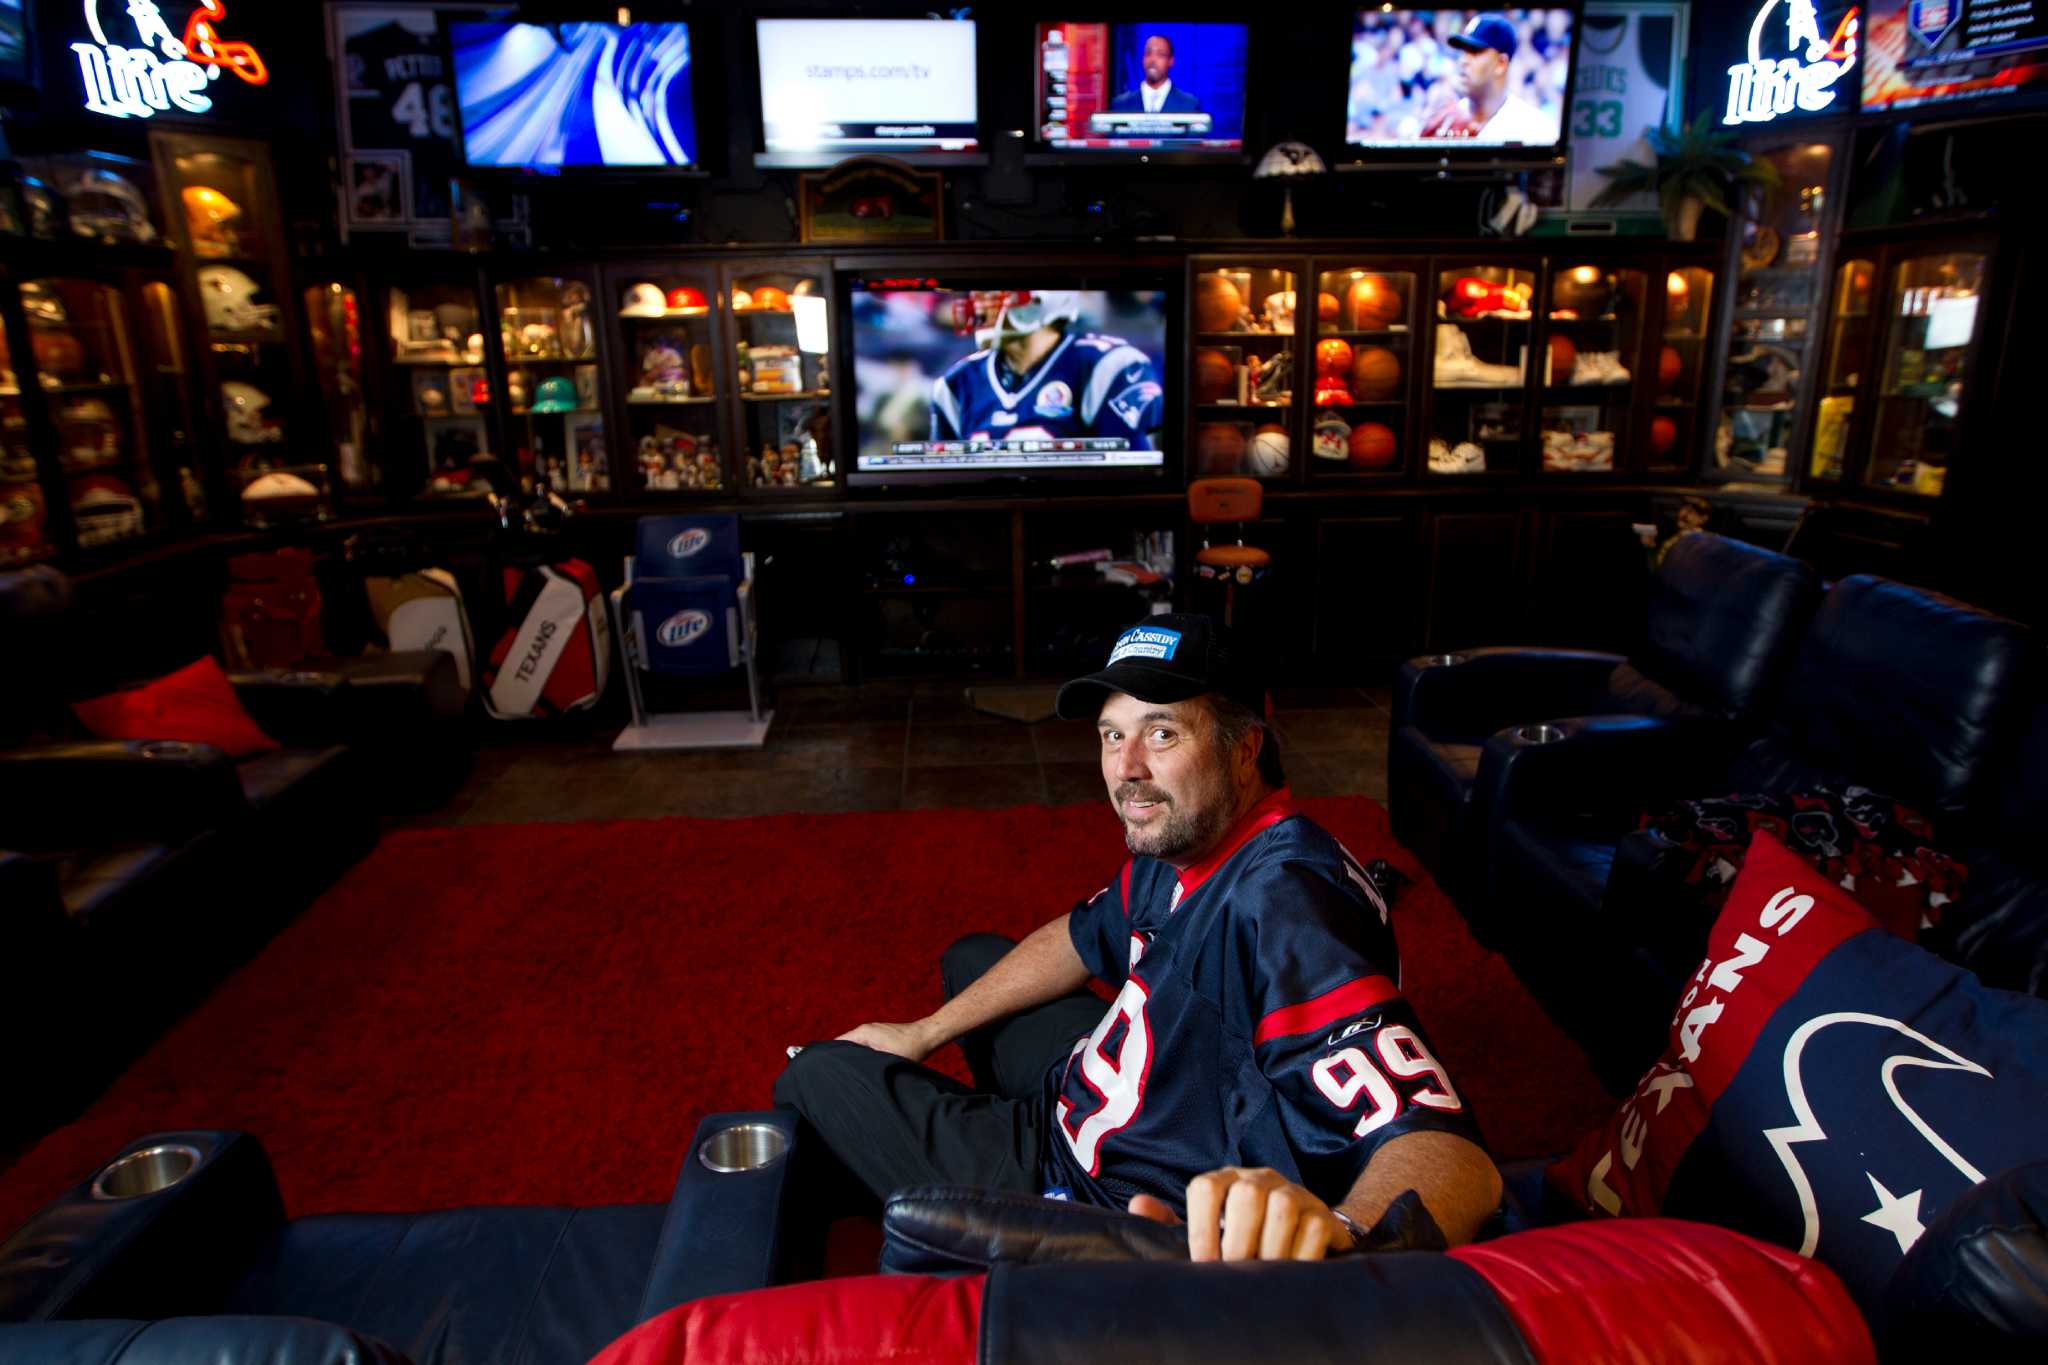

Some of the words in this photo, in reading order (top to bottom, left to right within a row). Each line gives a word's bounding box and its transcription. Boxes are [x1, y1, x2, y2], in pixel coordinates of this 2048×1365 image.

[807, 63, 930, 84] stamps.com/tv
[1574, 100, 1623, 137] 33
[514, 620, 557, 683] TEXANS
[1130, 628, 1178, 645] CASSIDY
[1311, 1023, 1463, 1140] 99
